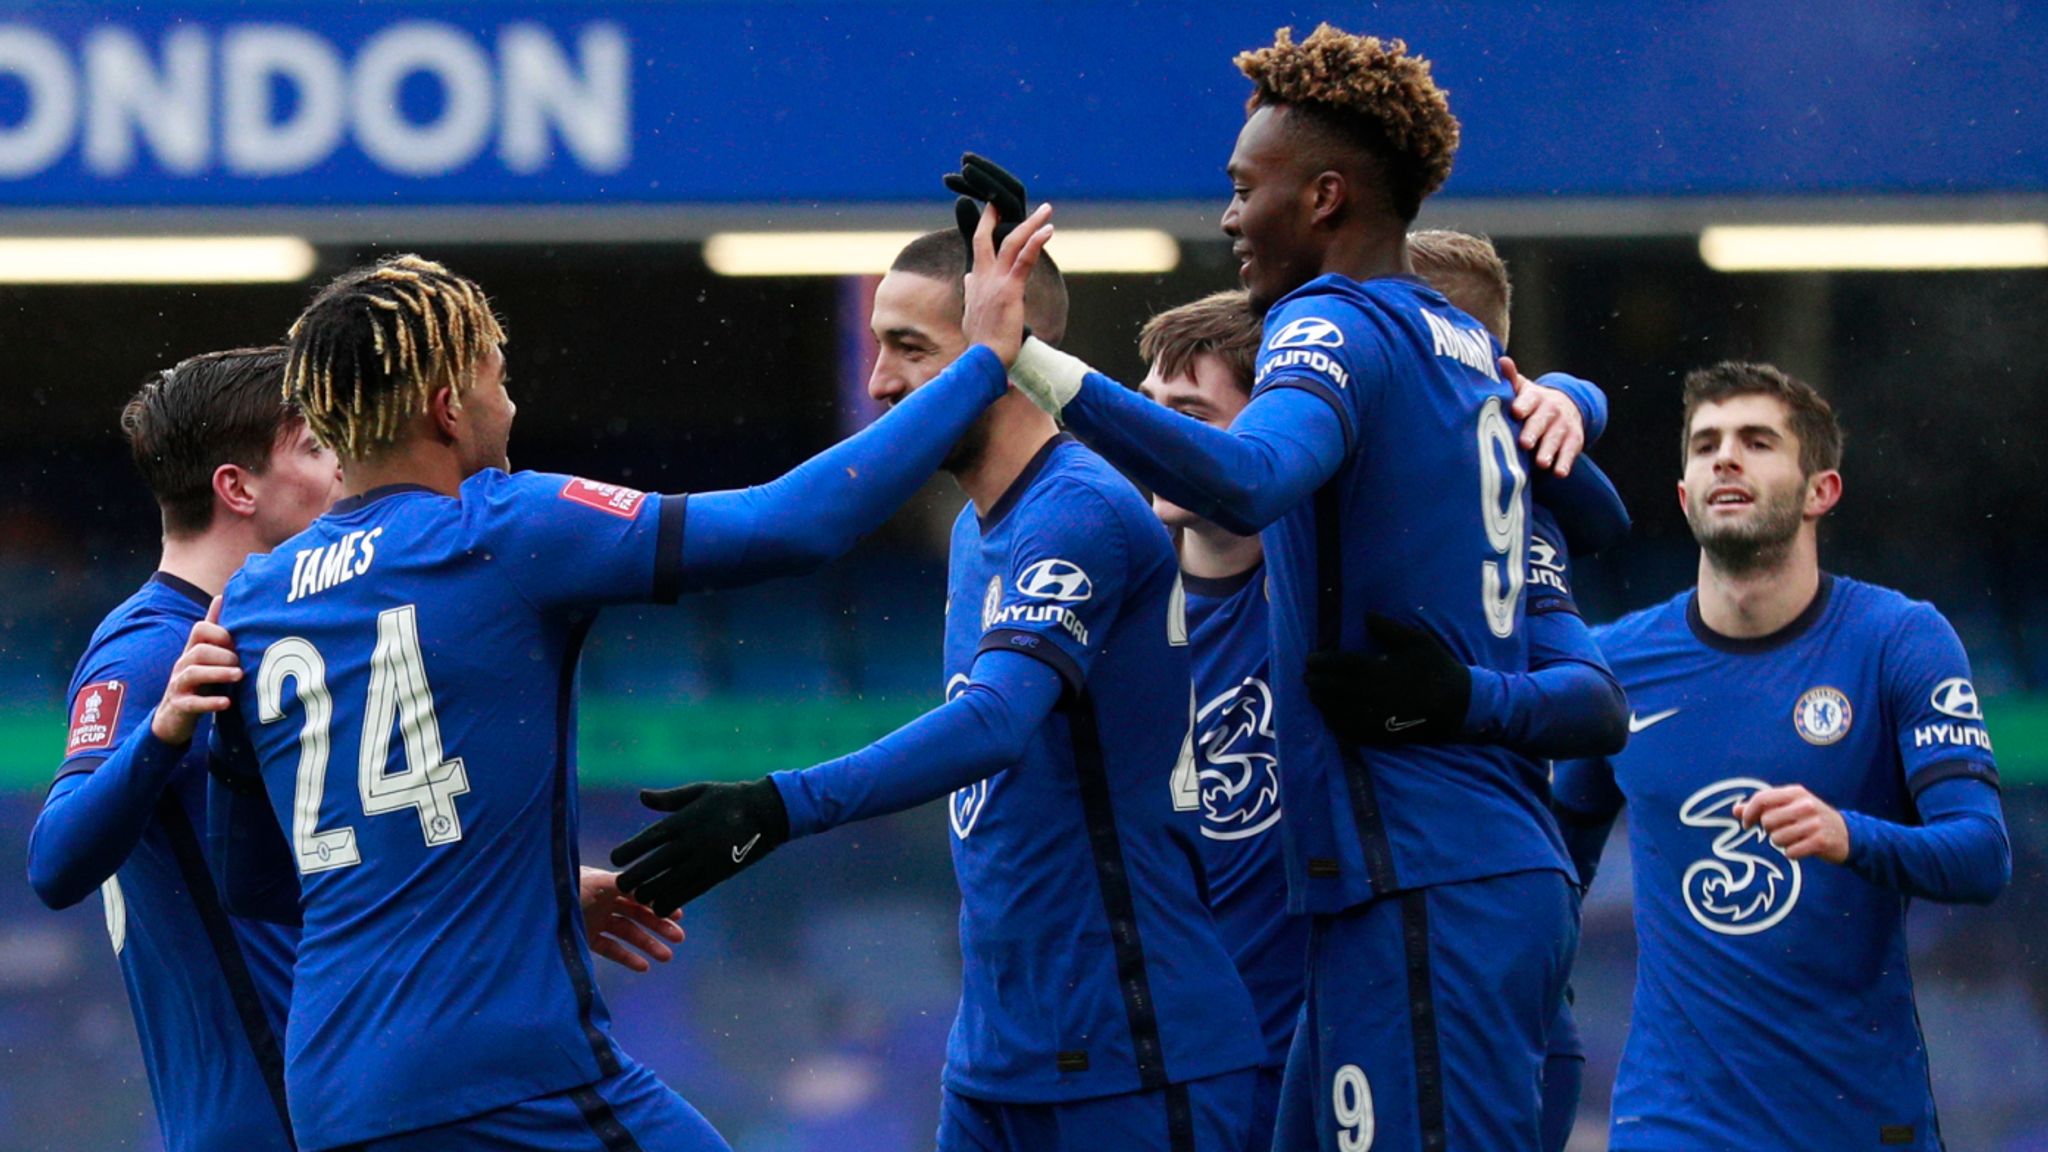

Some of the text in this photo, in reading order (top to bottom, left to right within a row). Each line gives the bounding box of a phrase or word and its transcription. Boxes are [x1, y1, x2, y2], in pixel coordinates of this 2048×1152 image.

[1477, 395, 1527, 639] 9
[286, 526, 384, 603] JAMES
[993, 604, 1089, 646] HYUNDAI
[81, 732, 106, 743] CUP
[256, 604, 471, 875] 24
[1332, 1063, 1375, 1152] 9
